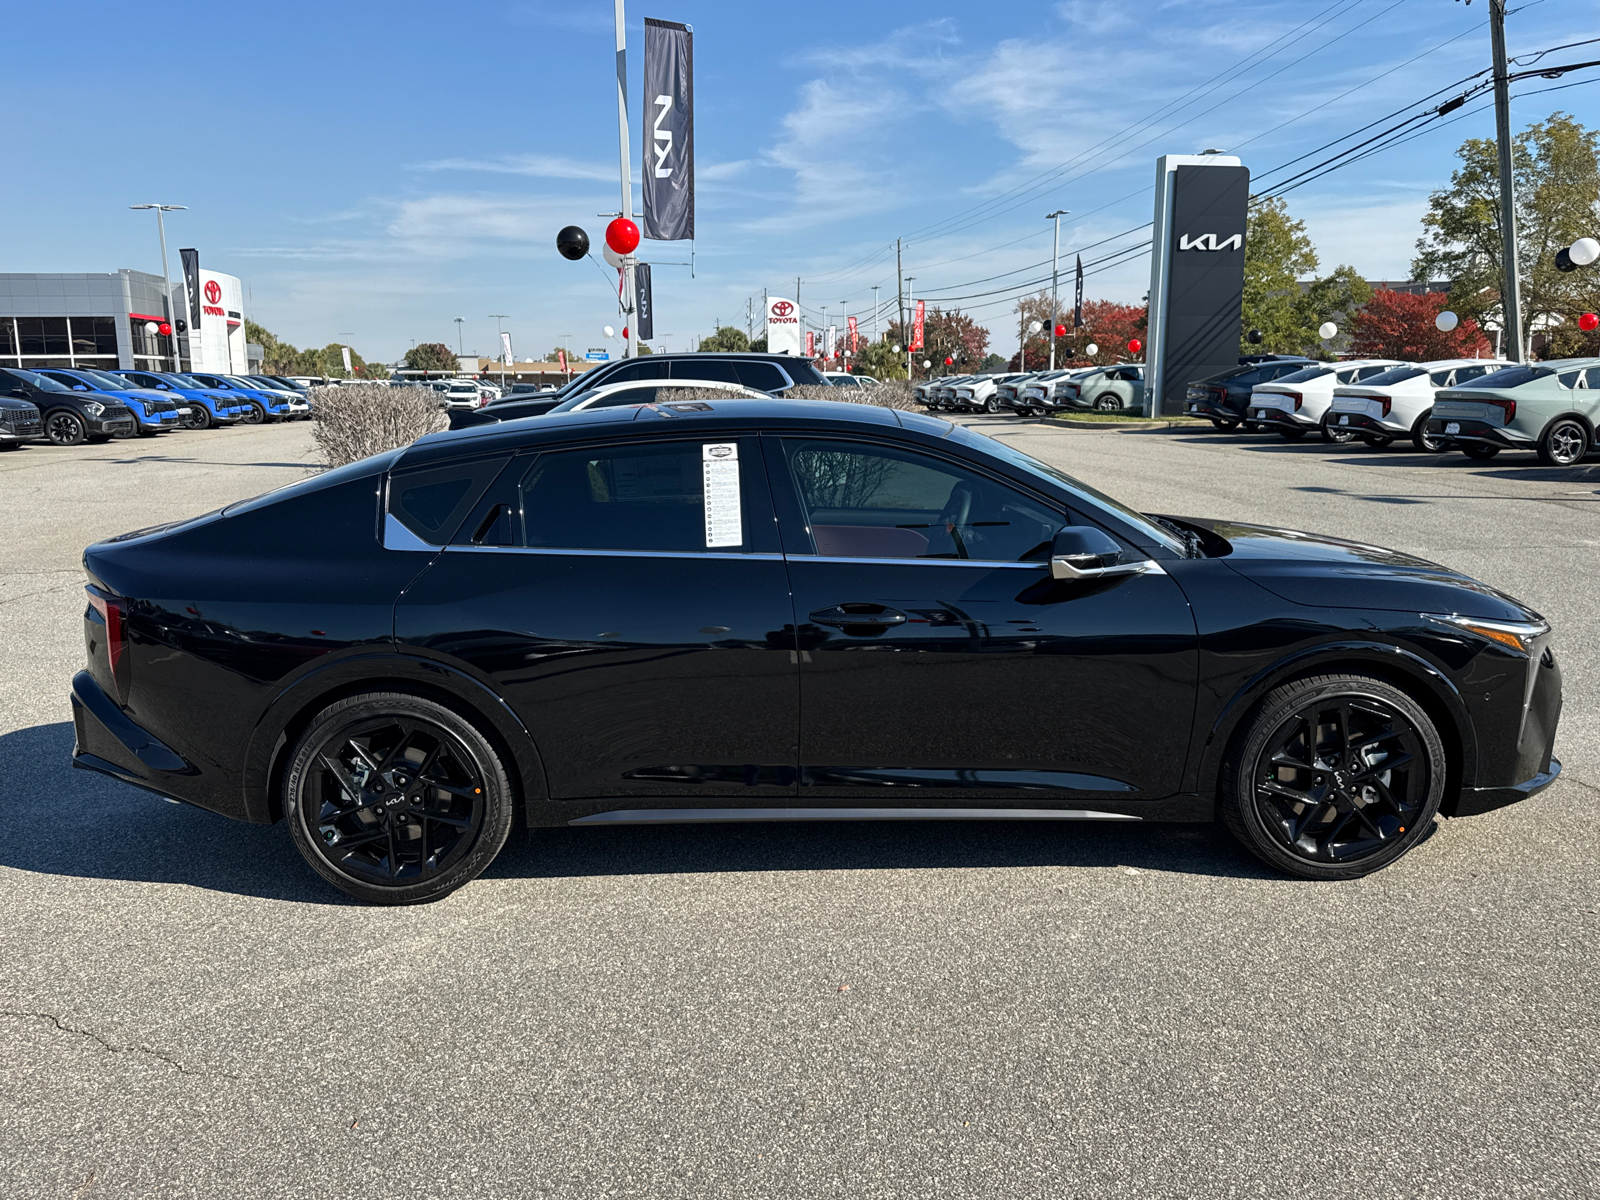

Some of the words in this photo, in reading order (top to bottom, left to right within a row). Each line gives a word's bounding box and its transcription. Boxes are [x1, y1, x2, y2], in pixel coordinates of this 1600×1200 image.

[1178, 232, 1242, 251] KIA
[202, 305, 225, 317] TOYOTA
[768, 317, 798, 325] TOYOTA
[1274, 704, 1292, 721] 91W
[385, 794, 406, 807] KIA
